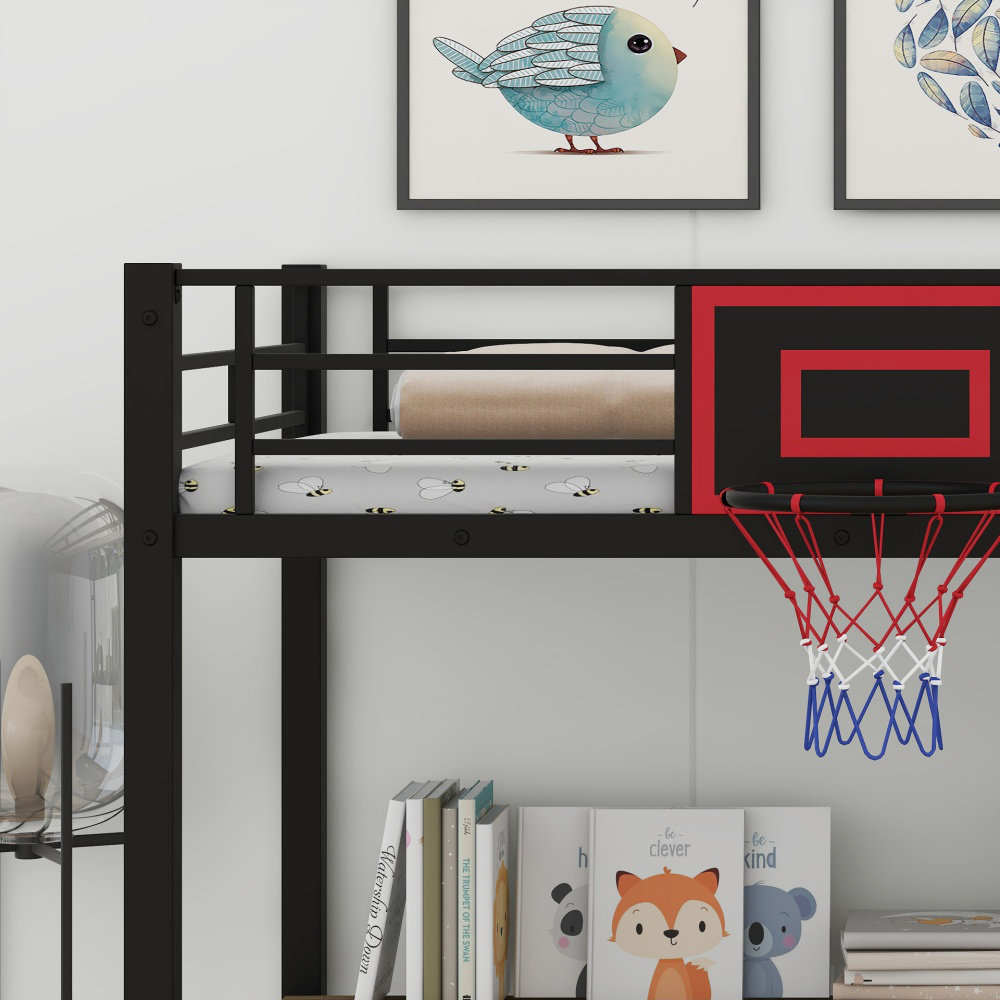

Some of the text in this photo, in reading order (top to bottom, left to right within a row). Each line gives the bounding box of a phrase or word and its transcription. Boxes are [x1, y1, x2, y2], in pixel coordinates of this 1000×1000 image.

[664, 826, 677, 840] be
[752, 831, 766, 847] be
[649, 840, 692, 858] clever
[360, 845, 397, 975] Watership Down
[462, 857, 471, 963] THE TRUMPET OF THE SWAN
